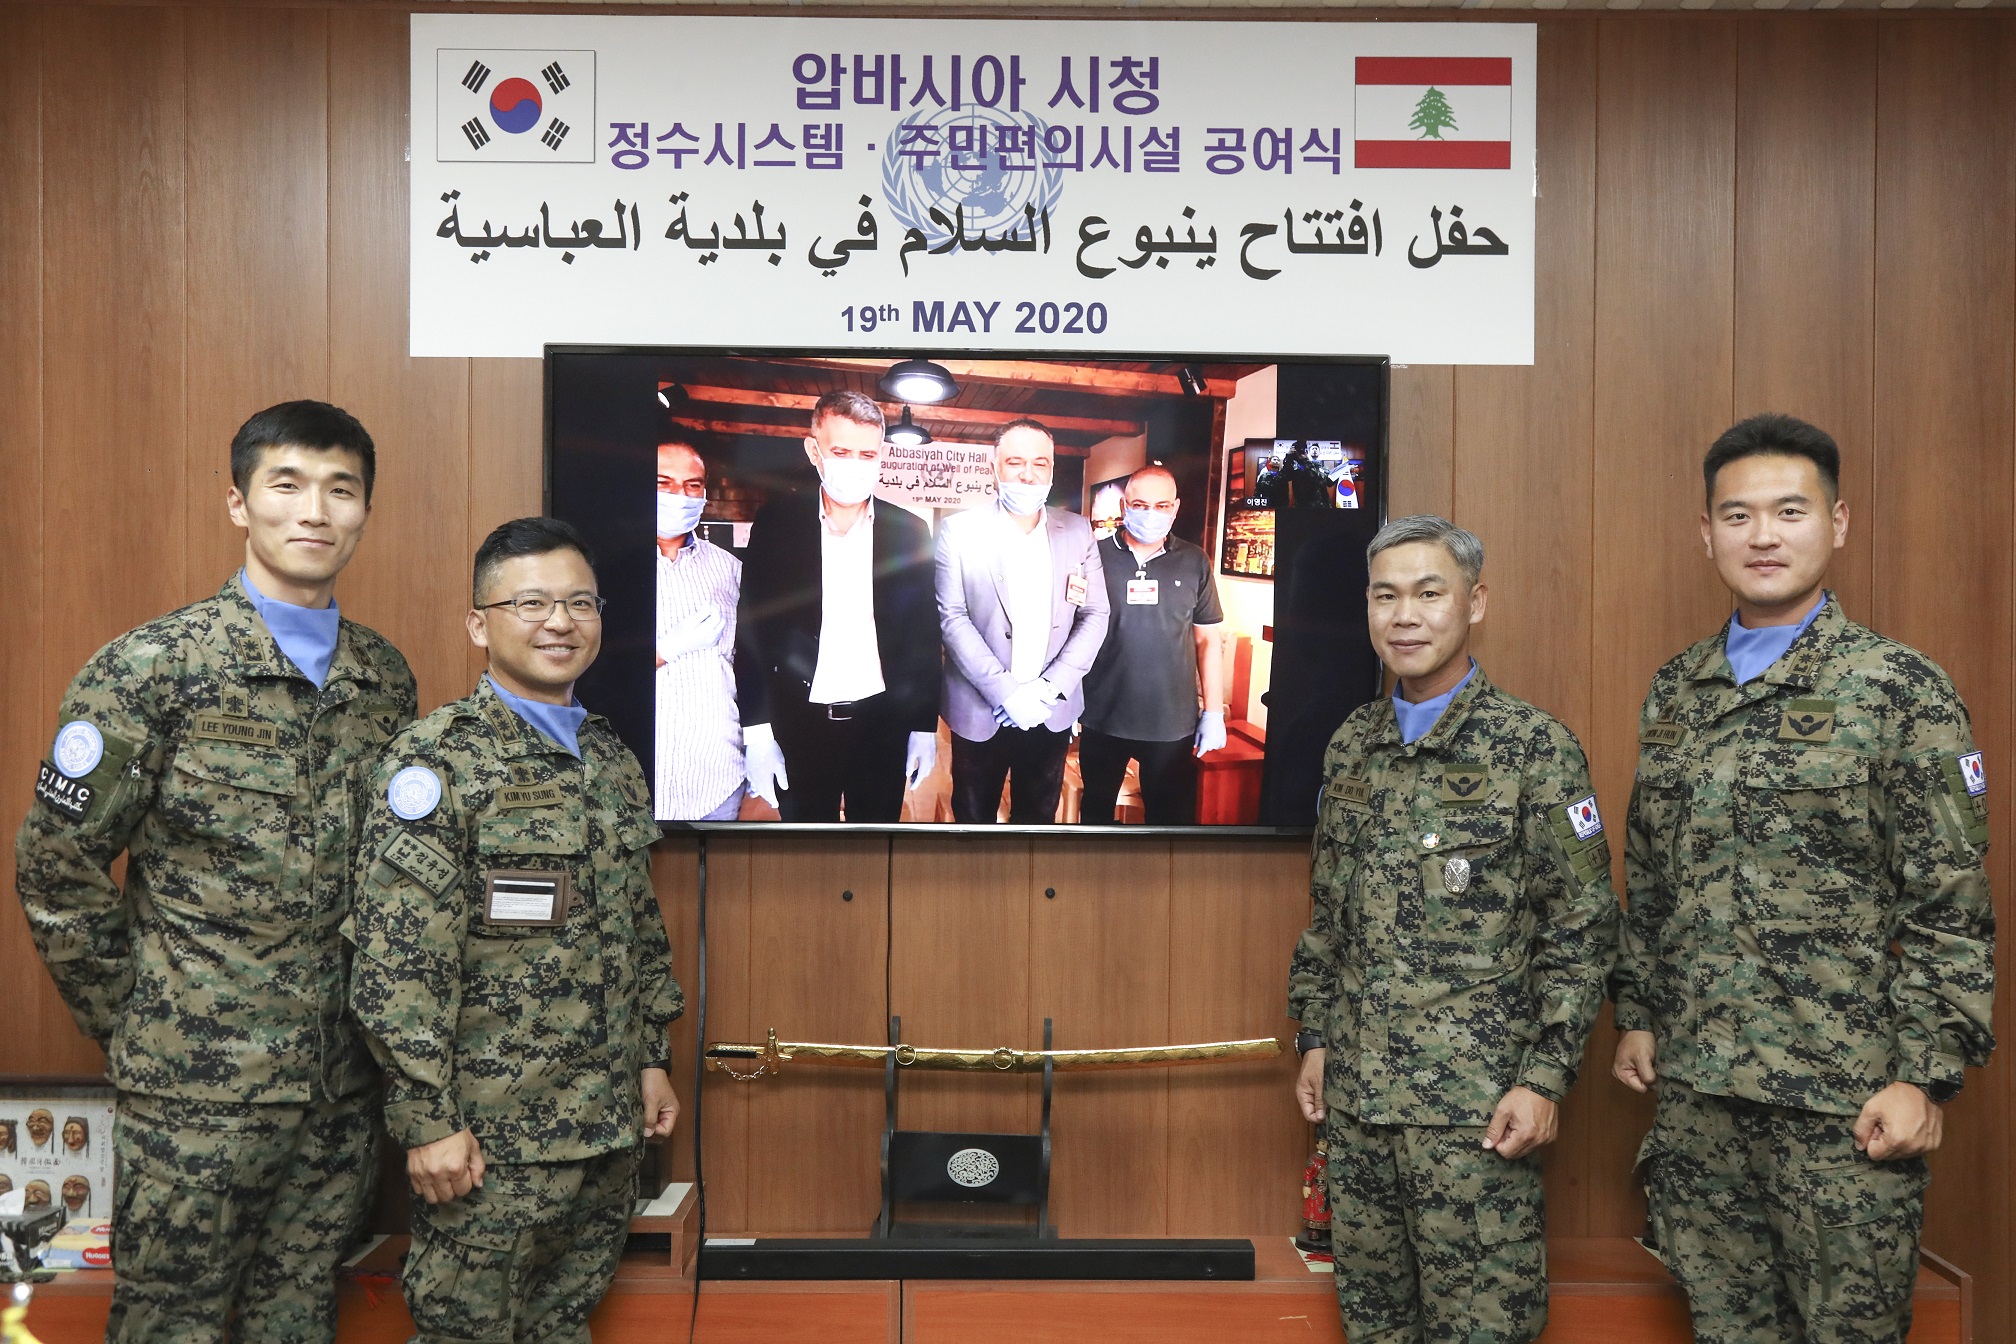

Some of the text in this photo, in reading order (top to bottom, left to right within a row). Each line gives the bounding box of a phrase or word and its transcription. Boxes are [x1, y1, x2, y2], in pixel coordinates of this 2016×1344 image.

[792, 53, 1160, 116] 압바시아 시청
[607, 122, 843, 170] 정수시스템
[898, 124, 1180, 173] 주민편의시설
[1204, 127, 1341, 175] 공여식
[436, 189, 1509, 281] حفل افتتاح ينبوع السلام في بلدية العباسية
[841, 301, 1108, 335] 19th MAY 2020
[880, 460, 928, 472] auguration
[942, 464, 960, 473] Well
[964, 465, 972, 474] of
[974, 466, 993, 475] Pea
[888, 446, 987, 464] Abbasiyah City Hall
[1246, 498, 1268, 507] 이영진
[201, 720, 272, 740] LEE YOUNG JIN
[41, 767, 90, 801] CIMIC
[504, 790, 556, 802] KIM YU SUNG
